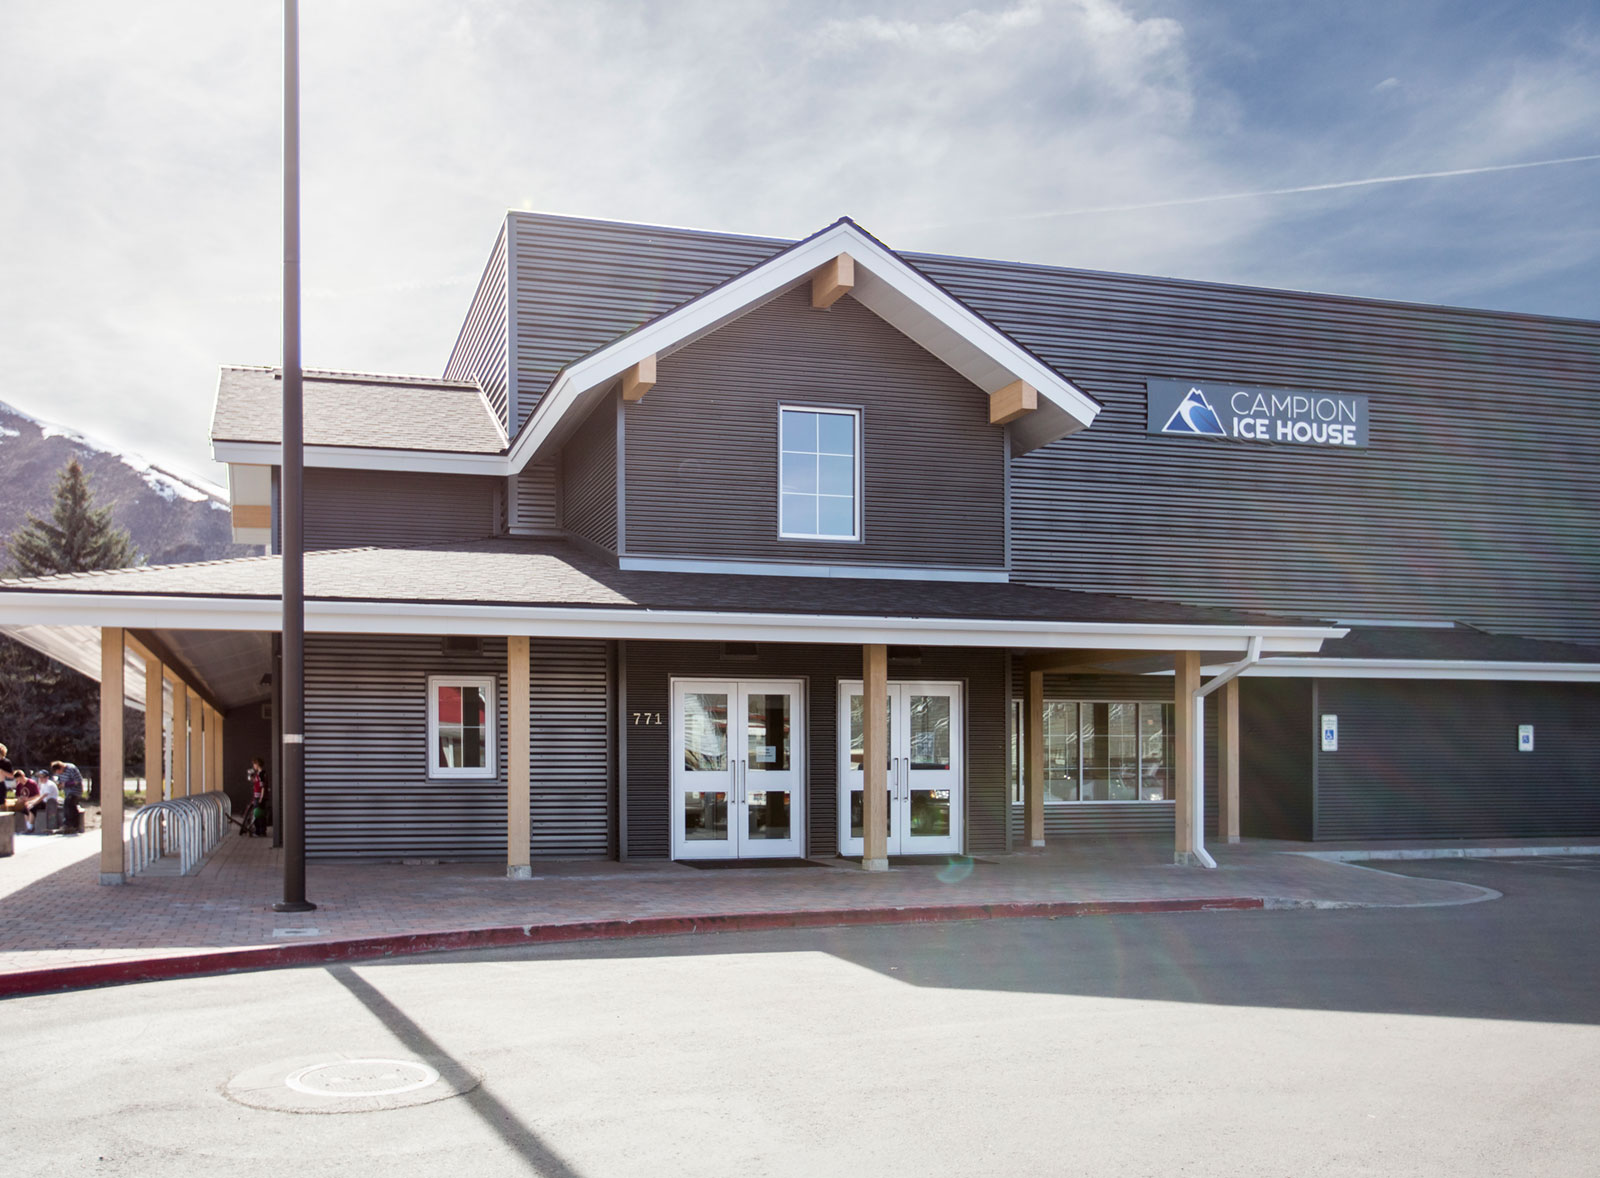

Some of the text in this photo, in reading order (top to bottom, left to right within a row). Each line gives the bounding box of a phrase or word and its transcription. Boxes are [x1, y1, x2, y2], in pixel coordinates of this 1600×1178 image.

[1231, 391, 1356, 422] CAMPION
[1233, 417, 1356, 445] ICE HOUSE
[633, 712, 663, 725] 771
